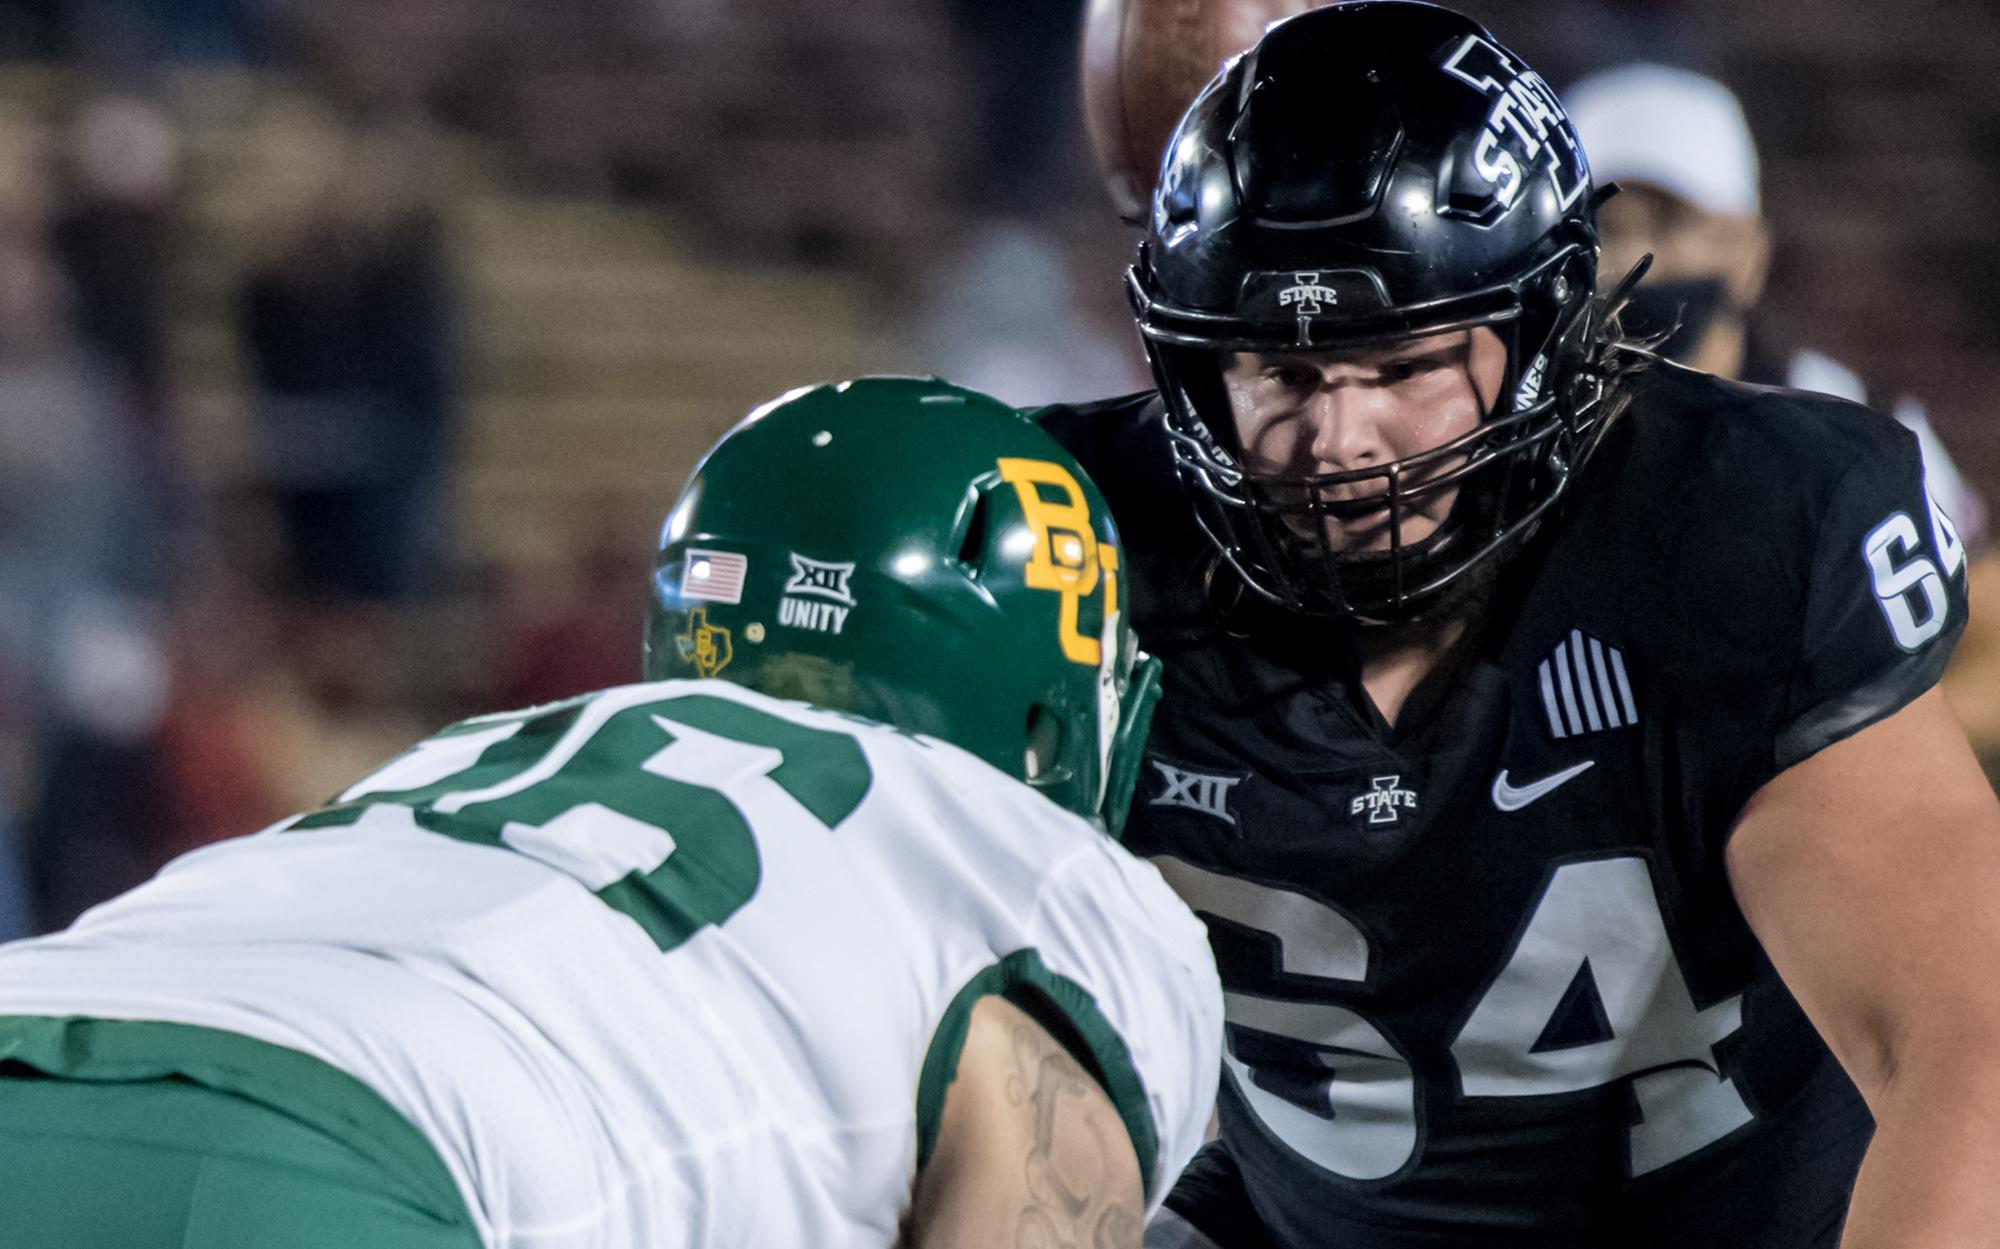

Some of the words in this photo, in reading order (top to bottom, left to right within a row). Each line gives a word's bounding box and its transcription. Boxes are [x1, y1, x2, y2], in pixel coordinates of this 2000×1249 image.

[1279, 285, 1337, 306] STATE
[786, 551, 855, 602] XII
[778, 597, 849, 635] UNITY
[1150, 760, 1240, 824] XII
[1352, 790, 1416, 815] STATE
[1148, 854, 1755, 1179] 64
